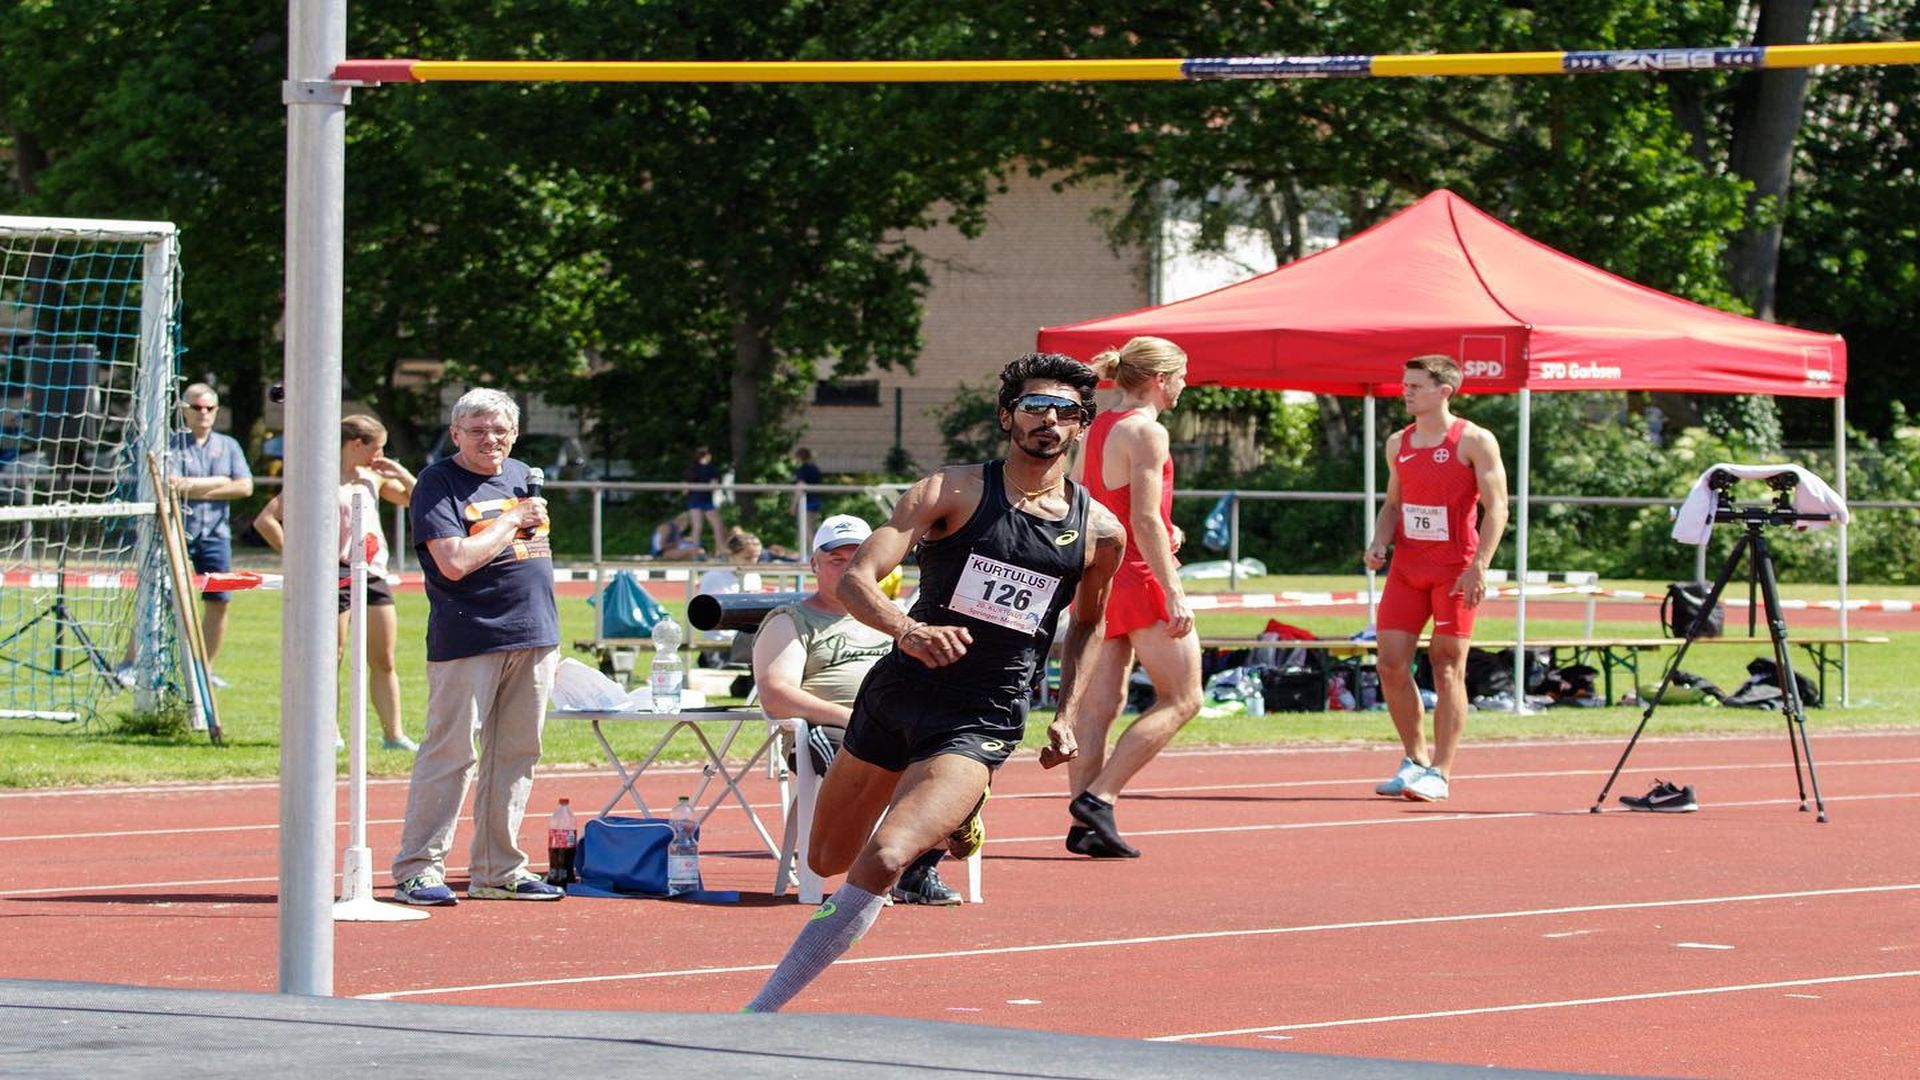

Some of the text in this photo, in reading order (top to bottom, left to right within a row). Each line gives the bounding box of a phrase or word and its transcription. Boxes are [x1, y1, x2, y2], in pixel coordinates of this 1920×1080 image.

[1614, 51, 1716, 70] BENZ
[1464, 360, 1503, 377] SPD
[1541, 361, 1621, 379] SPD Garbsen
[1414, 516, 1430, 529] 76
[973, 560, 1046, 588] KURTULUS
[983, 580, 1032, 611] 126
